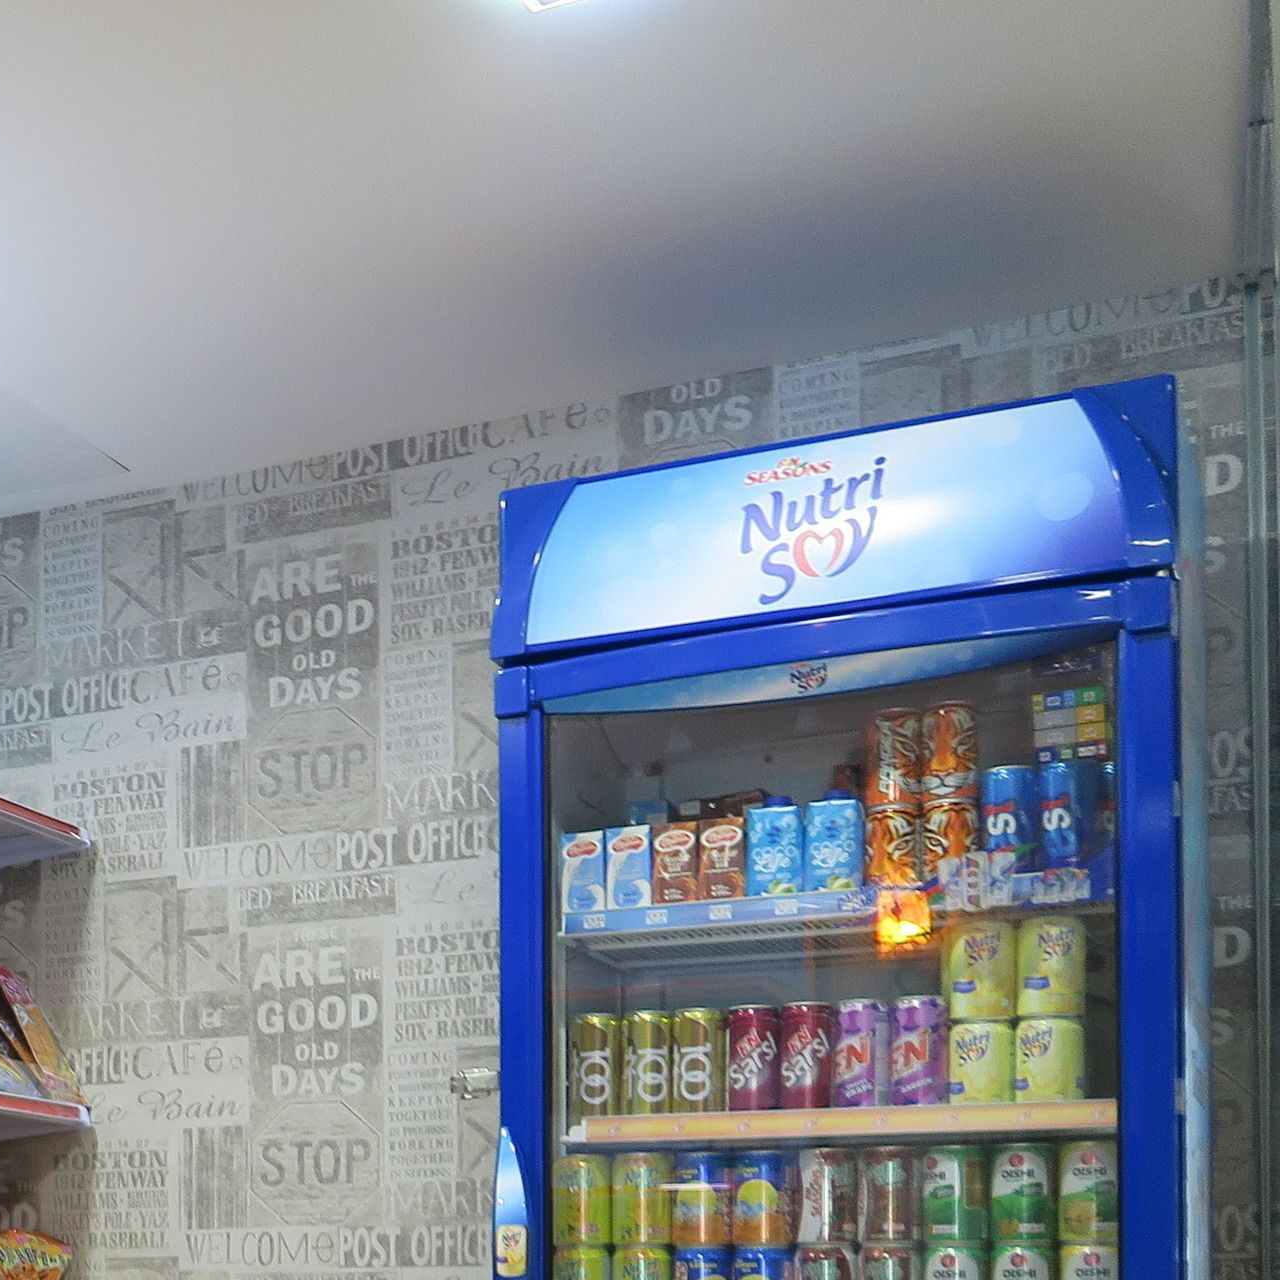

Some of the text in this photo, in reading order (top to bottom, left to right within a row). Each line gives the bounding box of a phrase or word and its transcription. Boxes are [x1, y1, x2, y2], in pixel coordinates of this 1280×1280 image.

[671, 377, 721, 403] OLD
[644, 396, 753, 446] DAYS
[744, 461, 833, 486] SEASONS
[741, 456, 887, 555] Nutri
[252, 555, 377, 605] ARE THE
[254, 600, 374, 647] GOOD
[293, 651, 336, 672] OLD
[1, 682, 56, 726] POST
[268, 668, 361, 708] DAYS
[258, 743, 366, 799] STOP
[337, 831, 396, 870] POST
[292, 873, 394, 905] BREAKFAST
[253, 946, 380, 992] ARE THE
[257, 993, 378, 1034] GOOD
[296, 1041, 338, 1061] OLD
[272, 1062, 366, 1098] DAYS
[139, 1089, 238, 1121] Bain
[260, 1139, 371, 1187] STOP
[340, 1228, 400, 1267] POST
